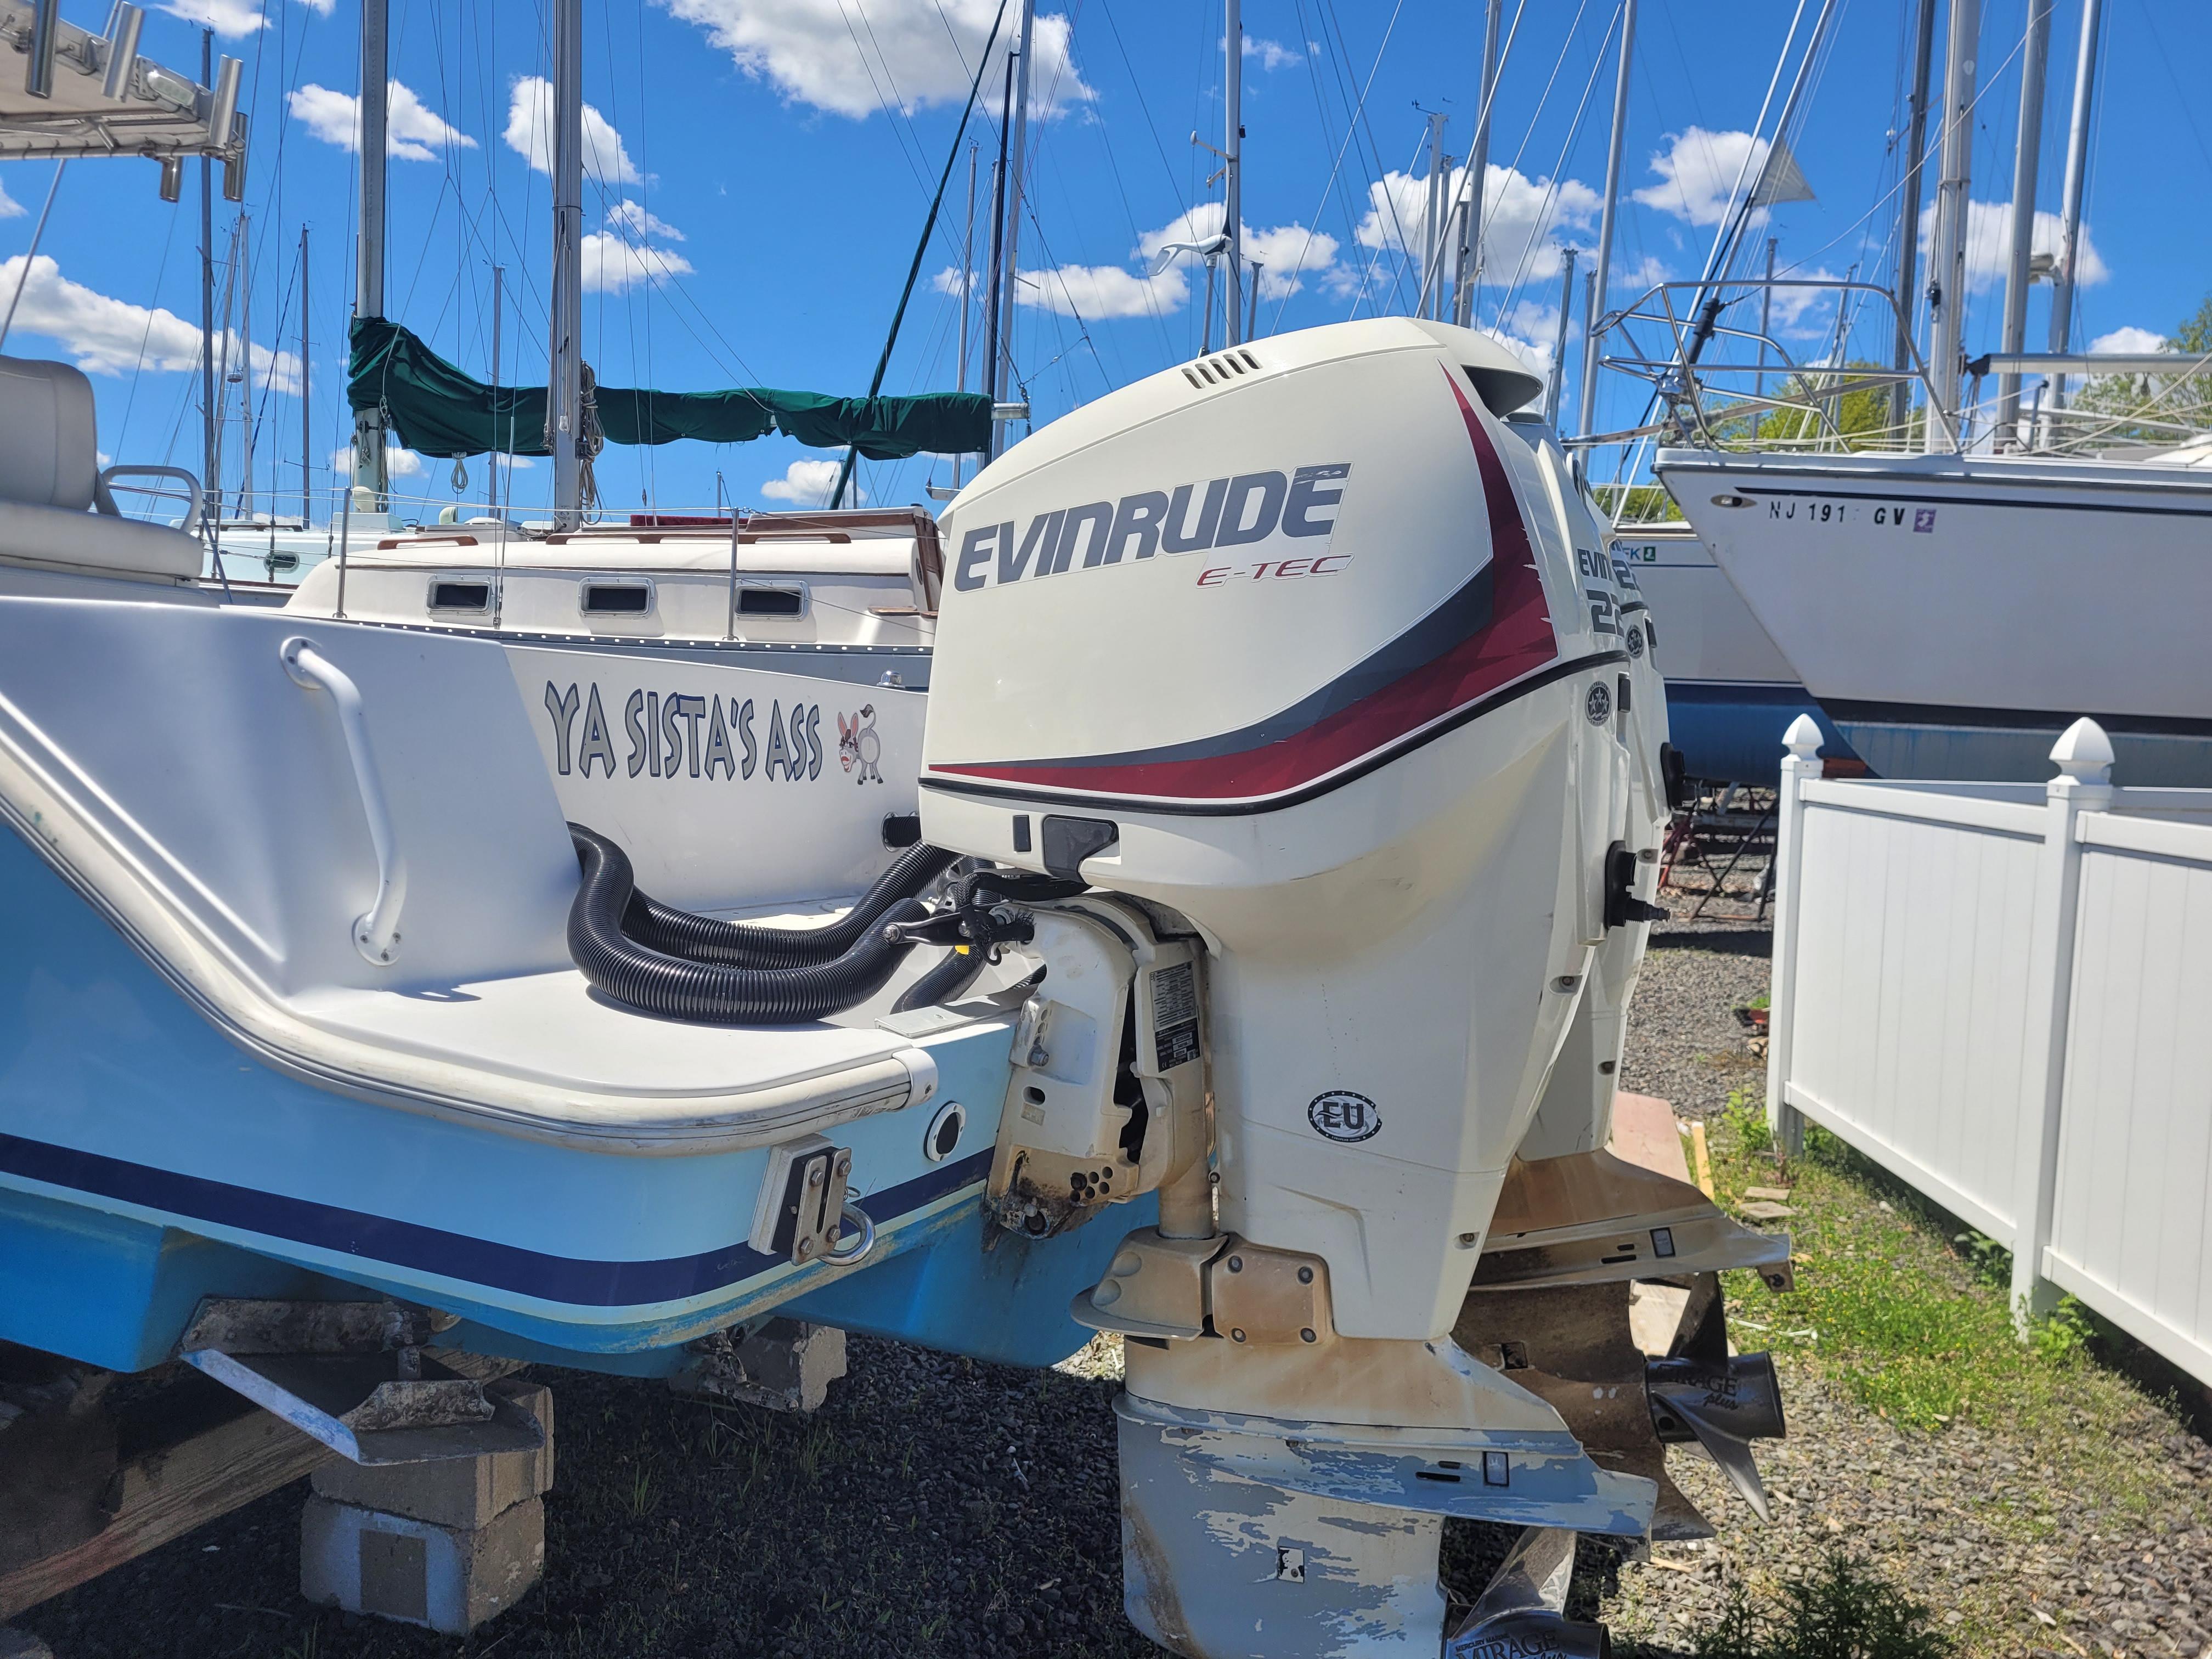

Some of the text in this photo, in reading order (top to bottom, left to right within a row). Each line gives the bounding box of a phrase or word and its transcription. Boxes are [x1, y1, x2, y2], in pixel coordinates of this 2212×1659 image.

[955, 462, 1351, 592] EVINRUDE
[1769, 501, 1796, 518] NJ
[1809, 503, 1845, 523] 191
[1874, 507, 1905, 525] GV
[1197, 554, 1352, 587] E-TEC
[544, 680, 822, 782] YA SISTA'S ASS
[1323, 1101, 1364, 1130] EU
[1455, 1638, 1485, 1652] MERCURY
